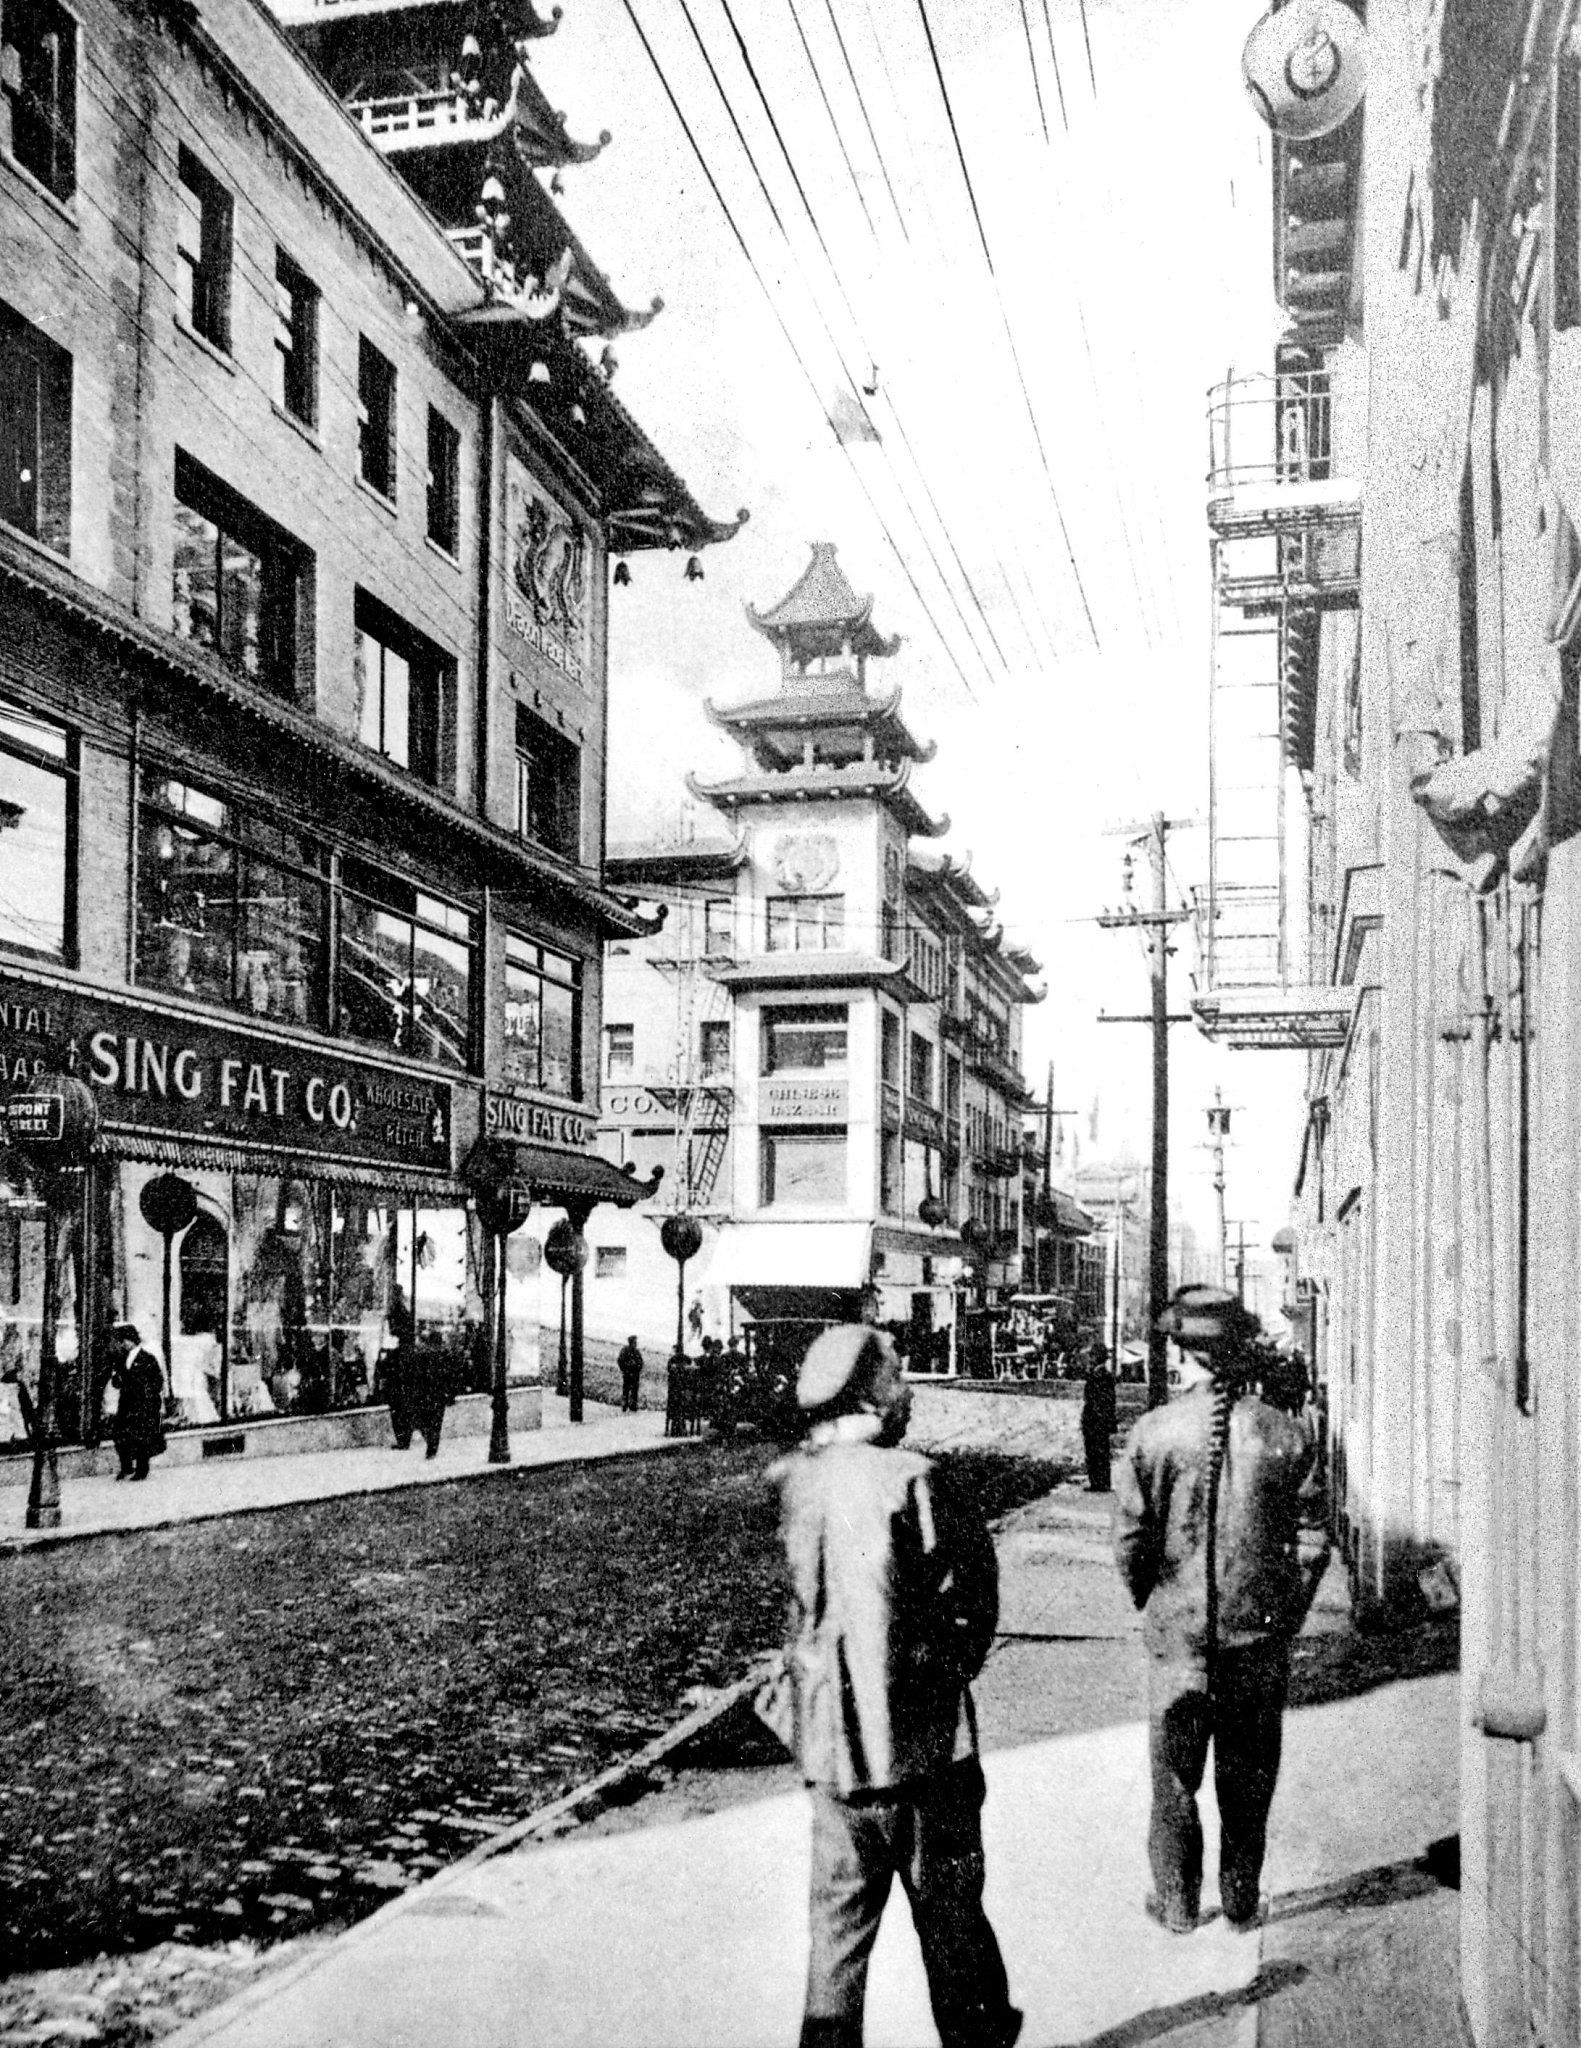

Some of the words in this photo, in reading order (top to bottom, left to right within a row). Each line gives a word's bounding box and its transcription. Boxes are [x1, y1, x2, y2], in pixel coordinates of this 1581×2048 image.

[90, 1031, 201, 1098] SING
[220, 1060, 290, 1116] FAT
[306, 1077, 357, 1130] CO.
[487, 1098, 527, 1132] SING
[532, 1108, 562, 1139] FAT
